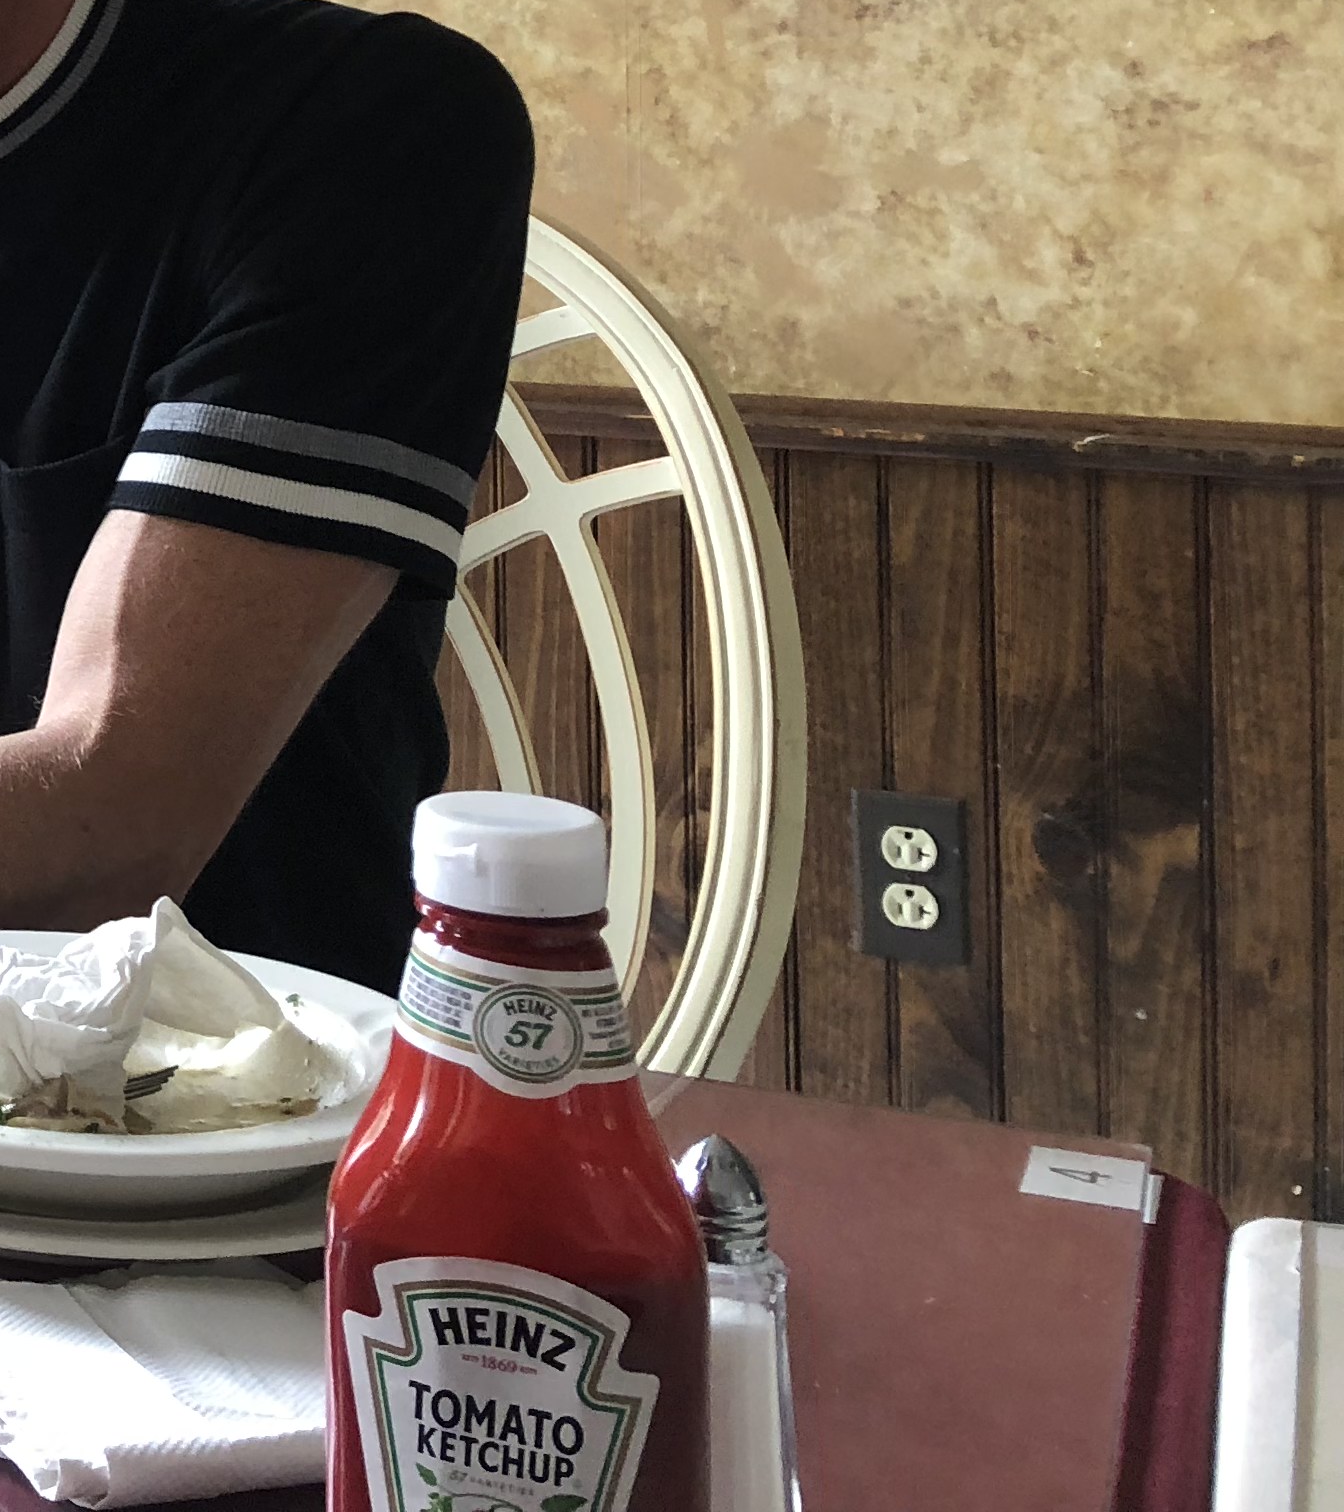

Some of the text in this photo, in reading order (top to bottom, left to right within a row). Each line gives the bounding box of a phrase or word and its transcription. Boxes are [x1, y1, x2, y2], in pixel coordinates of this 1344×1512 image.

[503, 998, 557, 1021] HEINZ
[504, 1020, 553, 1050] 57
[428, 1307, 576, 1372] HEINZ
[481, 1354, 518, 1374] 1869
[408, 1379, 584, 1456] TOMATO
[417, 1423, 575, 1487] KETCHUP
